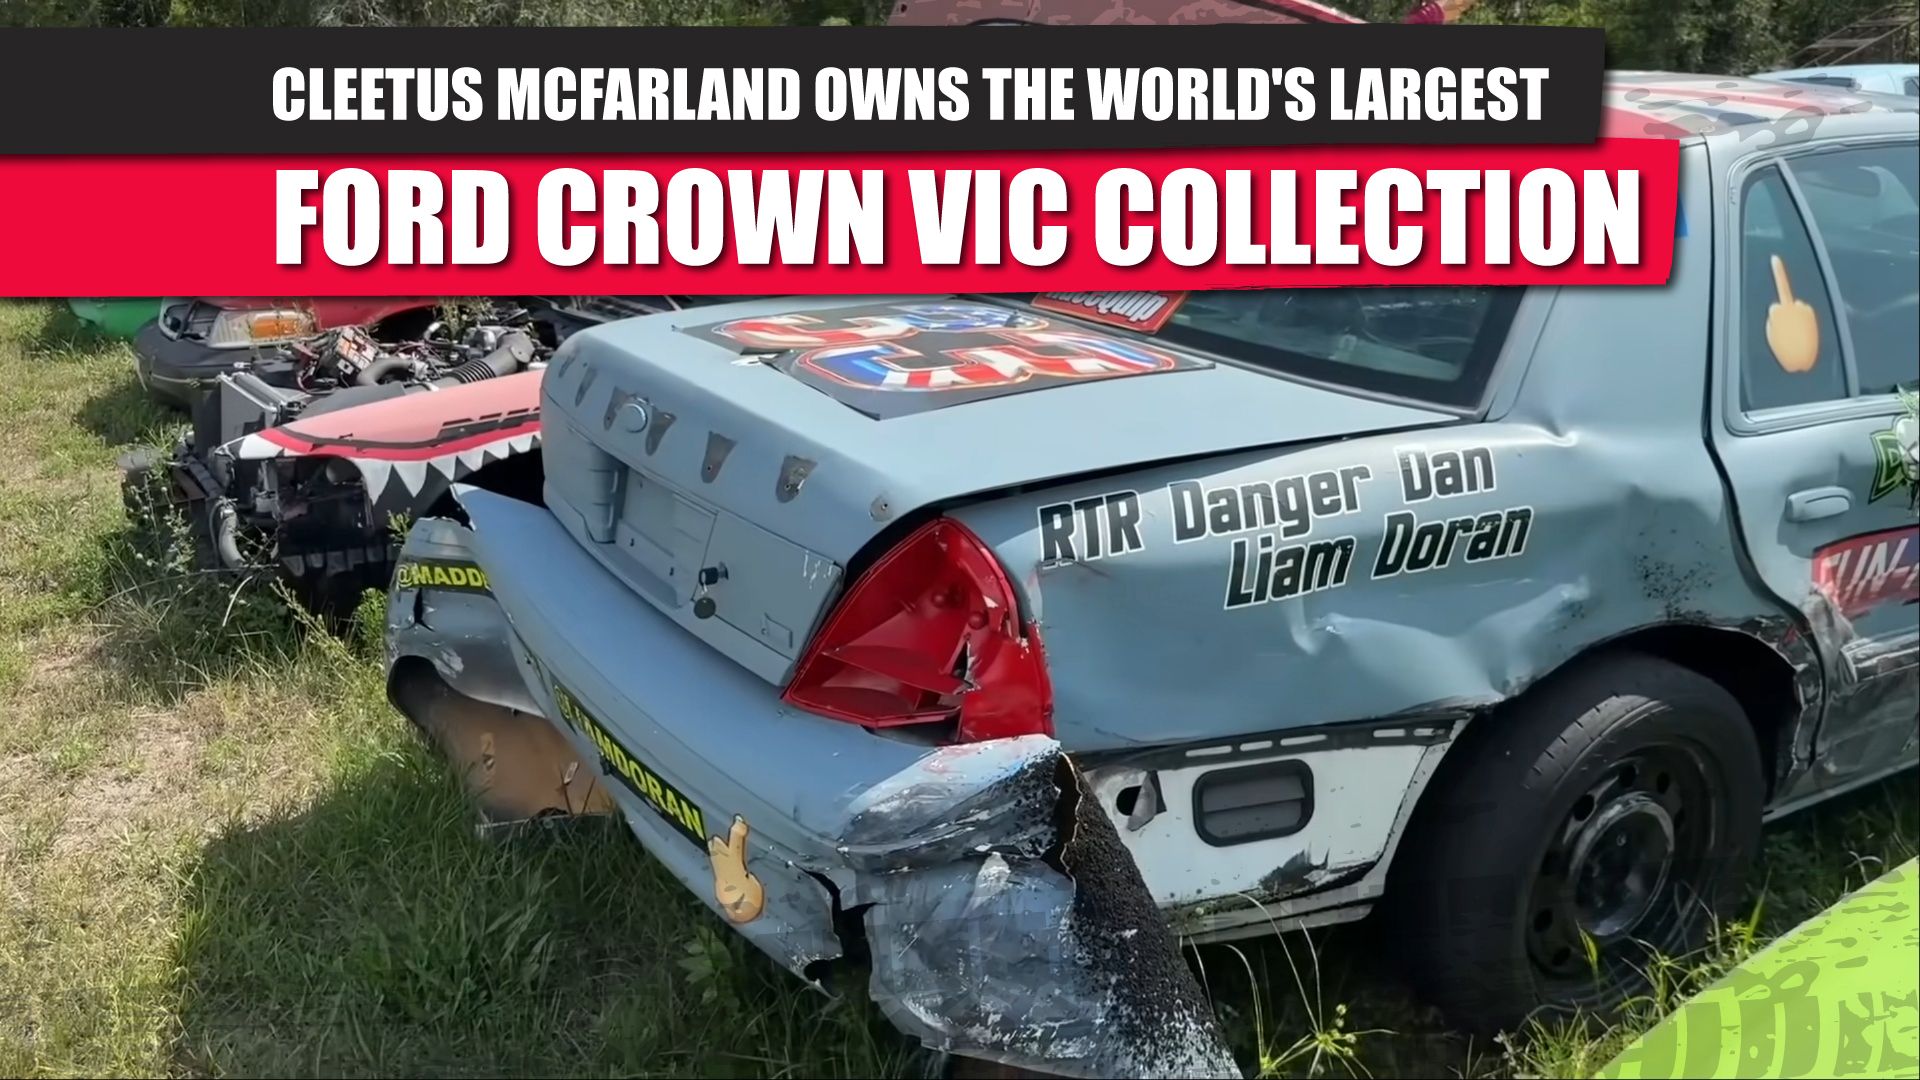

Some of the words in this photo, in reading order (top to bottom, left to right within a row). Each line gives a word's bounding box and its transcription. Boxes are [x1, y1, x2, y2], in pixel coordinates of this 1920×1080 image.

[1037, 490, 1142, 566] RTR
[1168, 464, 1373, 543] Danger
[1394, 445, 1496, 502] Dan
[396, 562, 491, 592] @MADD
[1224, 535, 1356, 609] Liam
[1371, 507, 1534, 579] Doran
